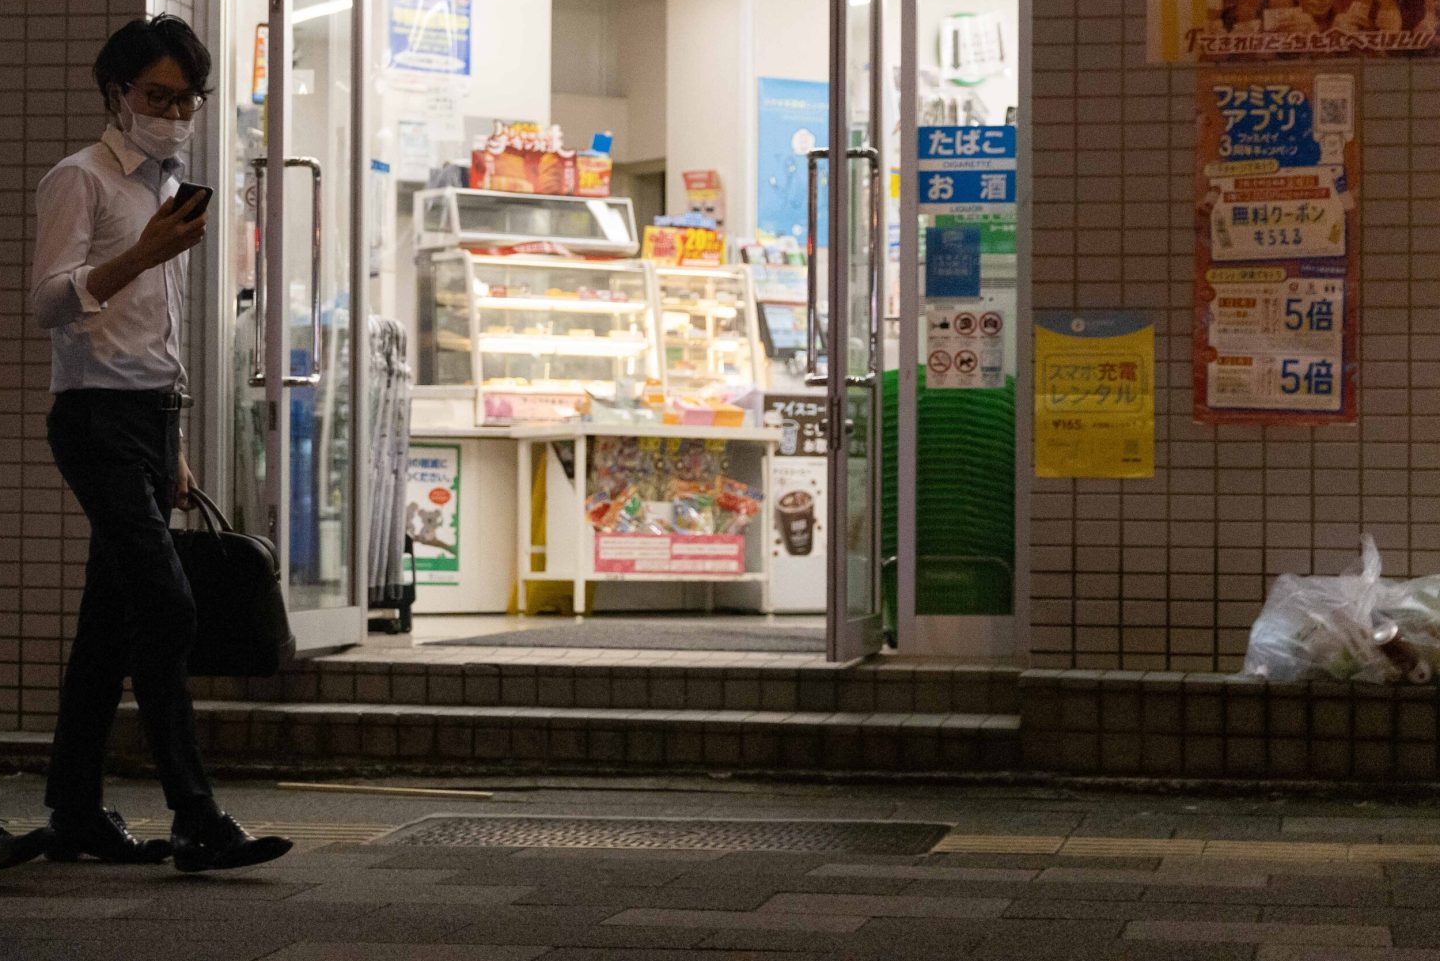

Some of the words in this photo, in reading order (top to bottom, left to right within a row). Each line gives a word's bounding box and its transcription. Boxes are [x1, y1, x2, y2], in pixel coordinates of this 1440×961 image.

[1213, 85, 1305, 107] ファミマの
[1222, 104, 1296, 132] アプリ
[928, 129, 1006, 156] たばこ
[1231, 204, 1325, 225] 無料クーポン
[1254, 228, 1302, 246] もらえる
[1285, 298, 1334, 331] 5倍
[1280, 359, 1334, 395] 5倍
[1051, 384, 1137, 405] レンタル
